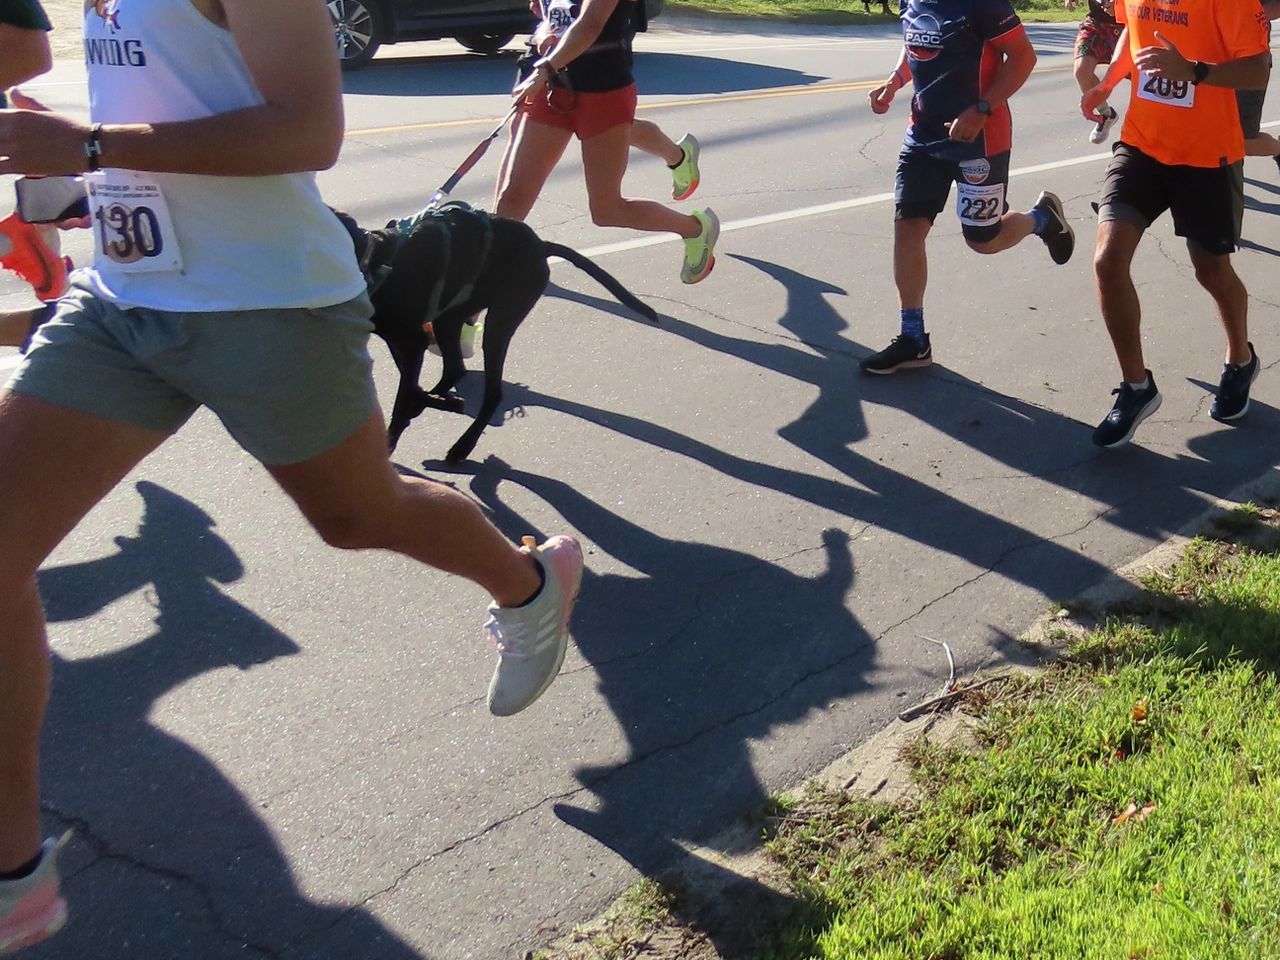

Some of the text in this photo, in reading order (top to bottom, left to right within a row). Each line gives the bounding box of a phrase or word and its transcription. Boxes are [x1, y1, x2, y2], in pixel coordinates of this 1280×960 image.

[1152, 7, 1189, 26] VETERANS
[906, 33, 940, 44] PAOC
[960, 197, 999, 220] 222
[95, 205, 163, 257] 130
